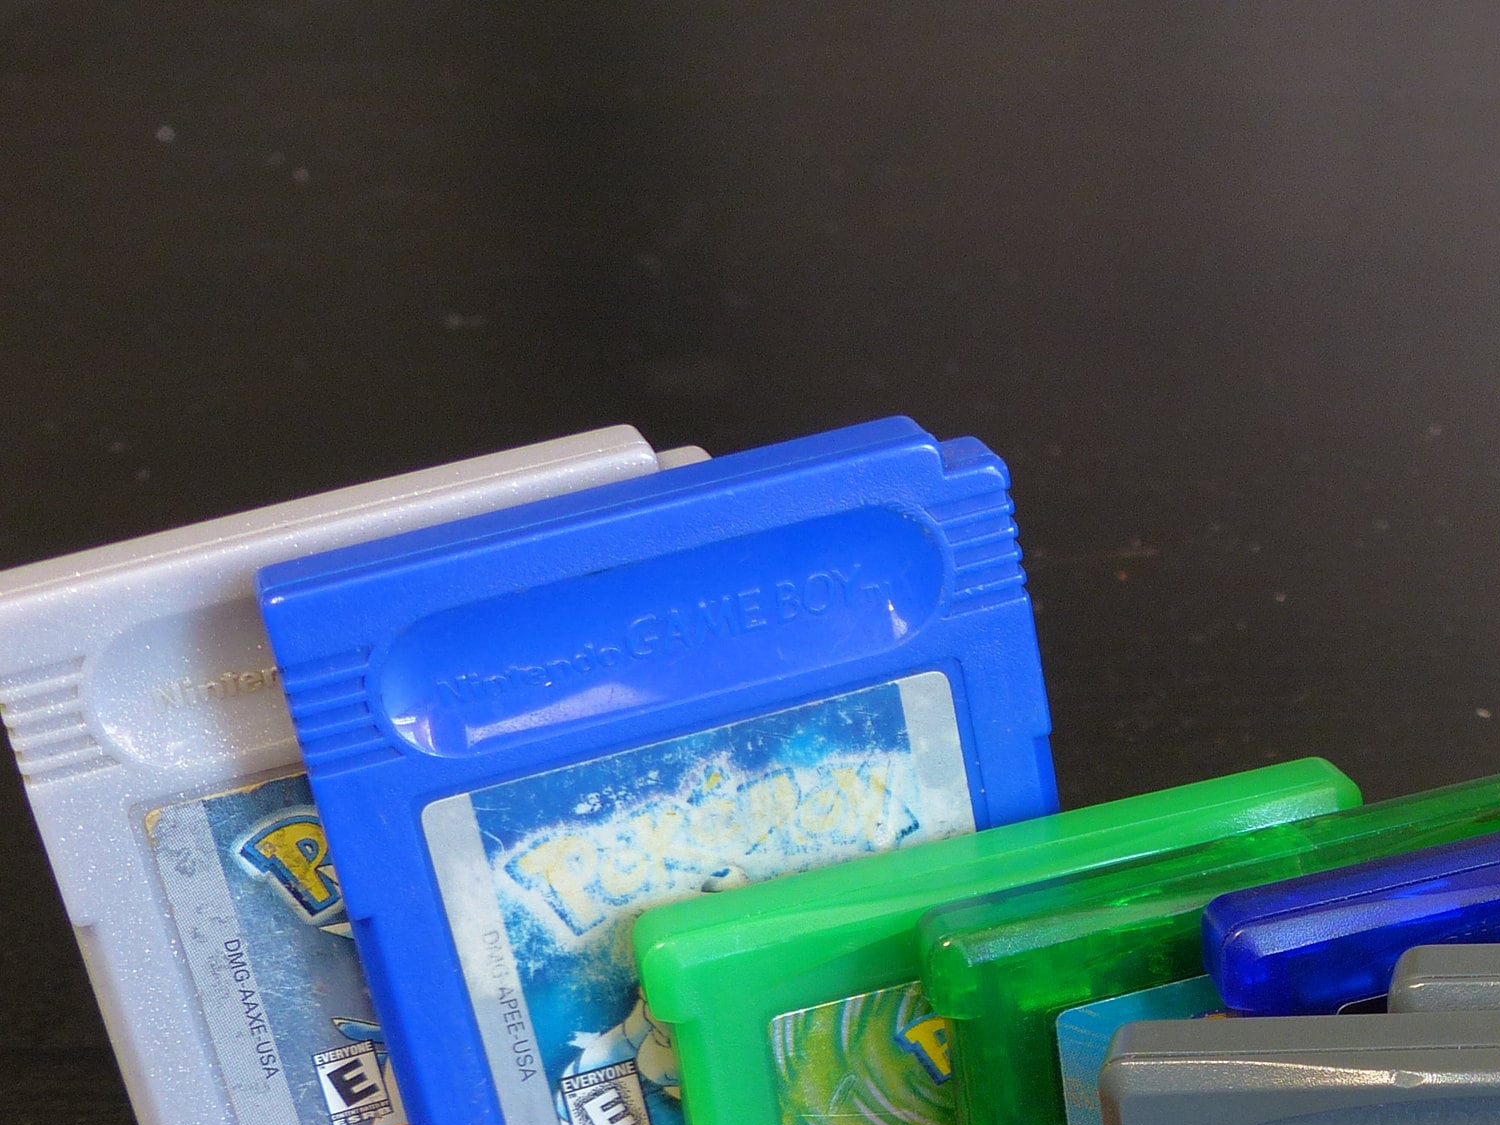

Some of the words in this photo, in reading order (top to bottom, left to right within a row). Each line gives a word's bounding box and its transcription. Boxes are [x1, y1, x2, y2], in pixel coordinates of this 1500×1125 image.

[626, 586, 768, 659] GAME
[775, 563, 862, 625] BOY
[223, 938, 280, 1080] DMG-AAXE-USA
[313, 1040, 374, 1065] EVERYONE
[562, 1060, 636, 1093] EVERYONE
[326, 1057, 381, 1107] E
